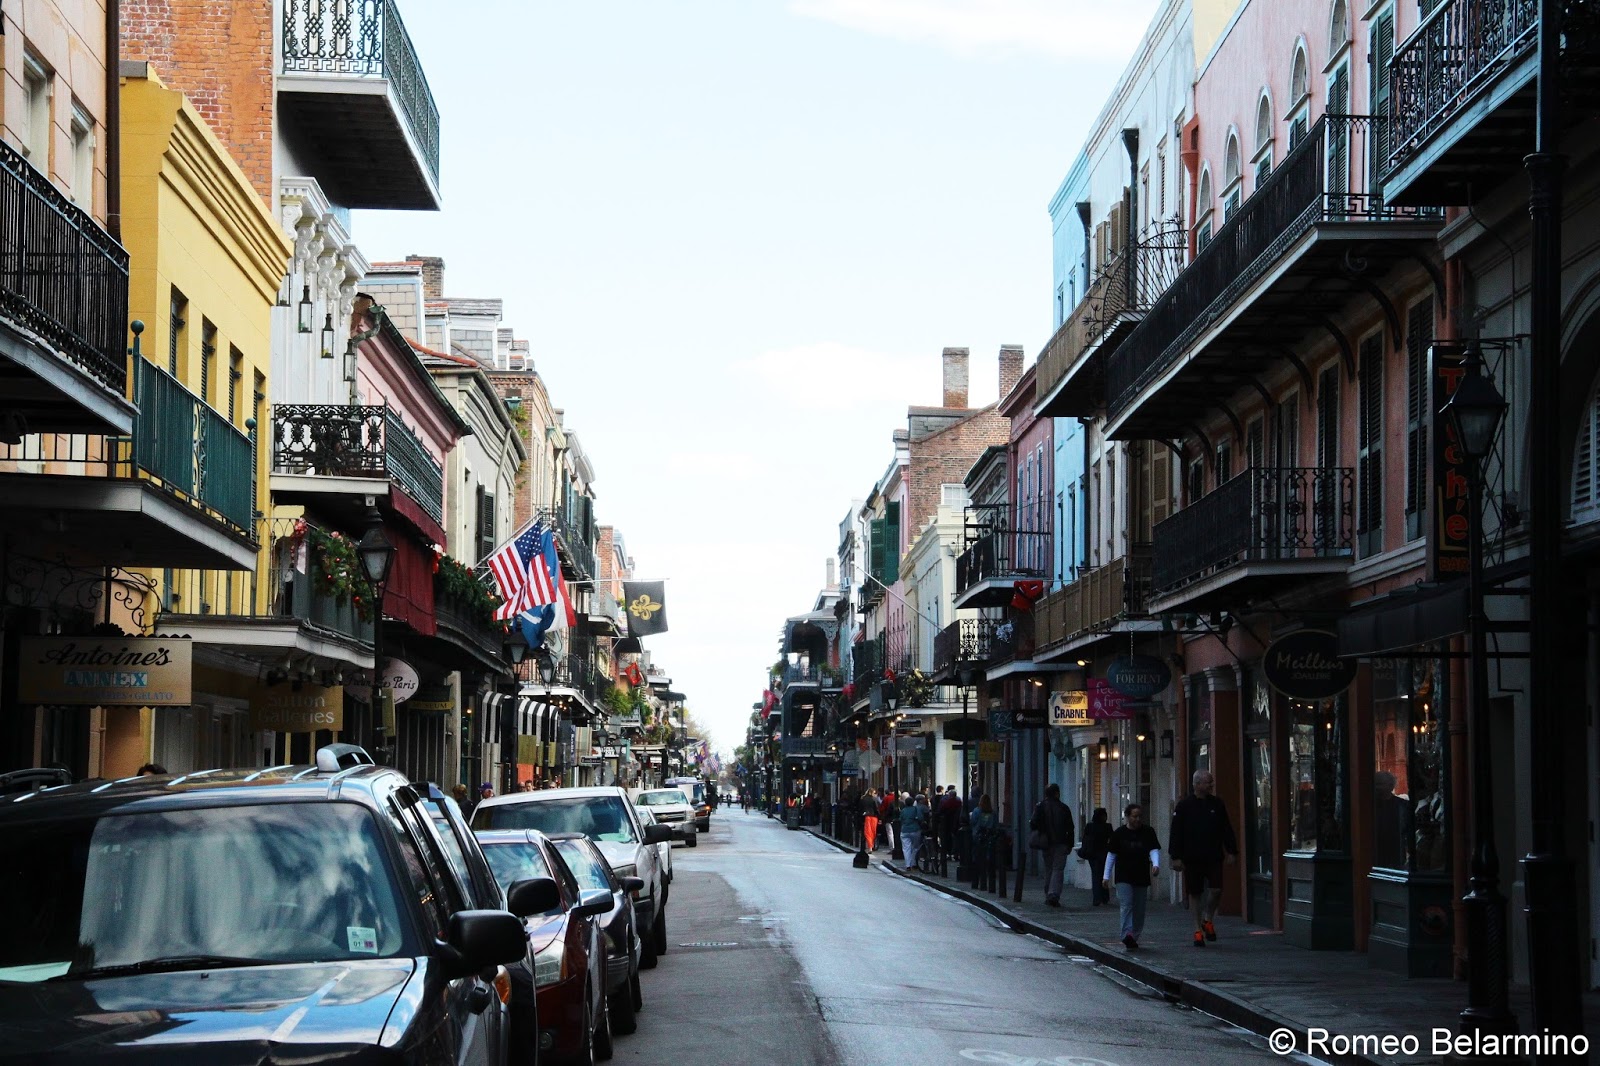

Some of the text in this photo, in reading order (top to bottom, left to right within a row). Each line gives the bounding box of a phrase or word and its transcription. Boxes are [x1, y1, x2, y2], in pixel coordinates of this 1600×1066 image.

[38, 643, 173, 666] Antoine's
[65, 671, 147, 687] ANNEX
[393, 675, 416, 690] Paris
[1115, 673, 1161, 684] FOR RENT
[1096, 681, 1119, 695] fee
[134, 691, 173, 700] GELATO
[267, 695, 326, 708] Sutton
[258, 709, 336, 725] Galleries
